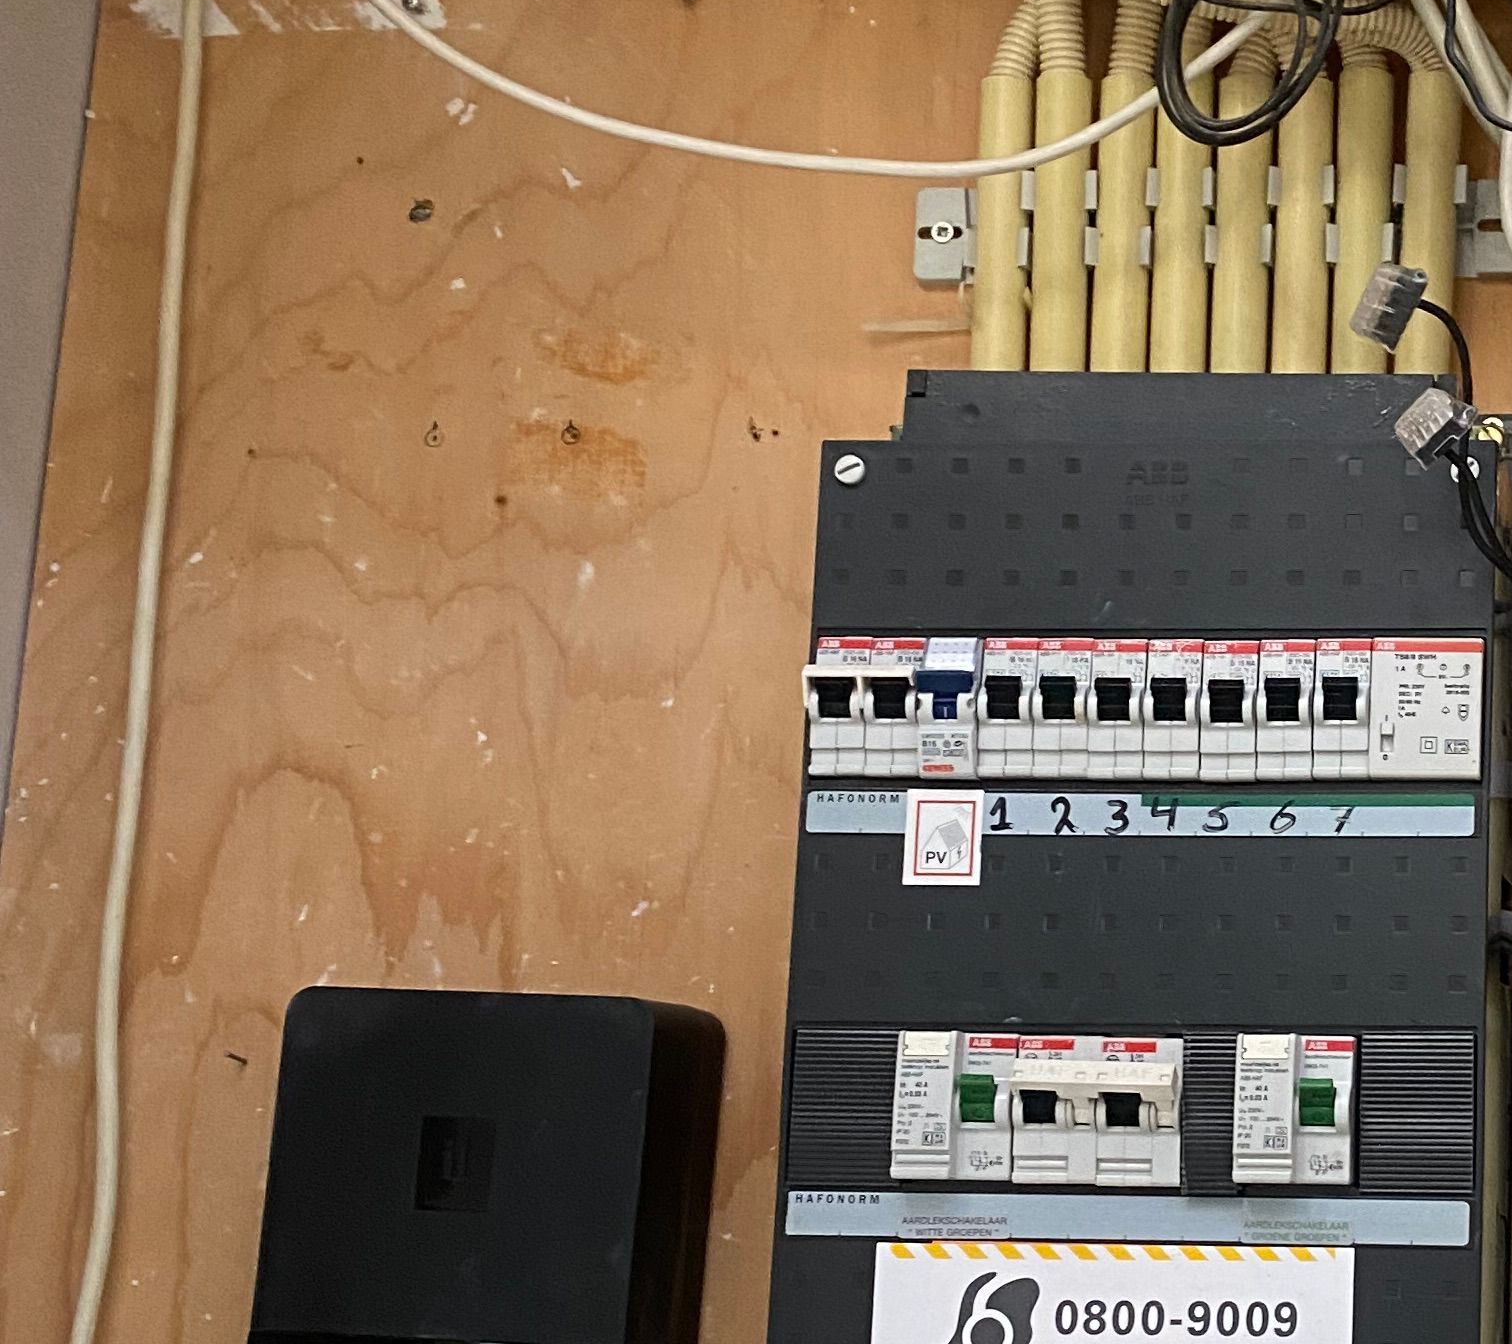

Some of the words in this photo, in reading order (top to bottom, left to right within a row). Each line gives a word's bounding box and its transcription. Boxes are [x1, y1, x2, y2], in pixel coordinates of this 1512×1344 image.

[817, 794, 900, 803] HAFONORM
[989, 797, 1013, 831] 1
[1051, 796, 1079, 835] 2
[1104, 800, 1129, 836] 3
[1150, 797, 1179, 832] 4
[1202, 800, 1240, 833] 5
[1269, 798, 1296, 834] 6
[1330, 805, 1356, 834] 7
[925, 851, 946, 865] PV
[795, 1194, 880, 1204] HAFONORM
[1055, 1299, 1297, 1337] 0800-9009
